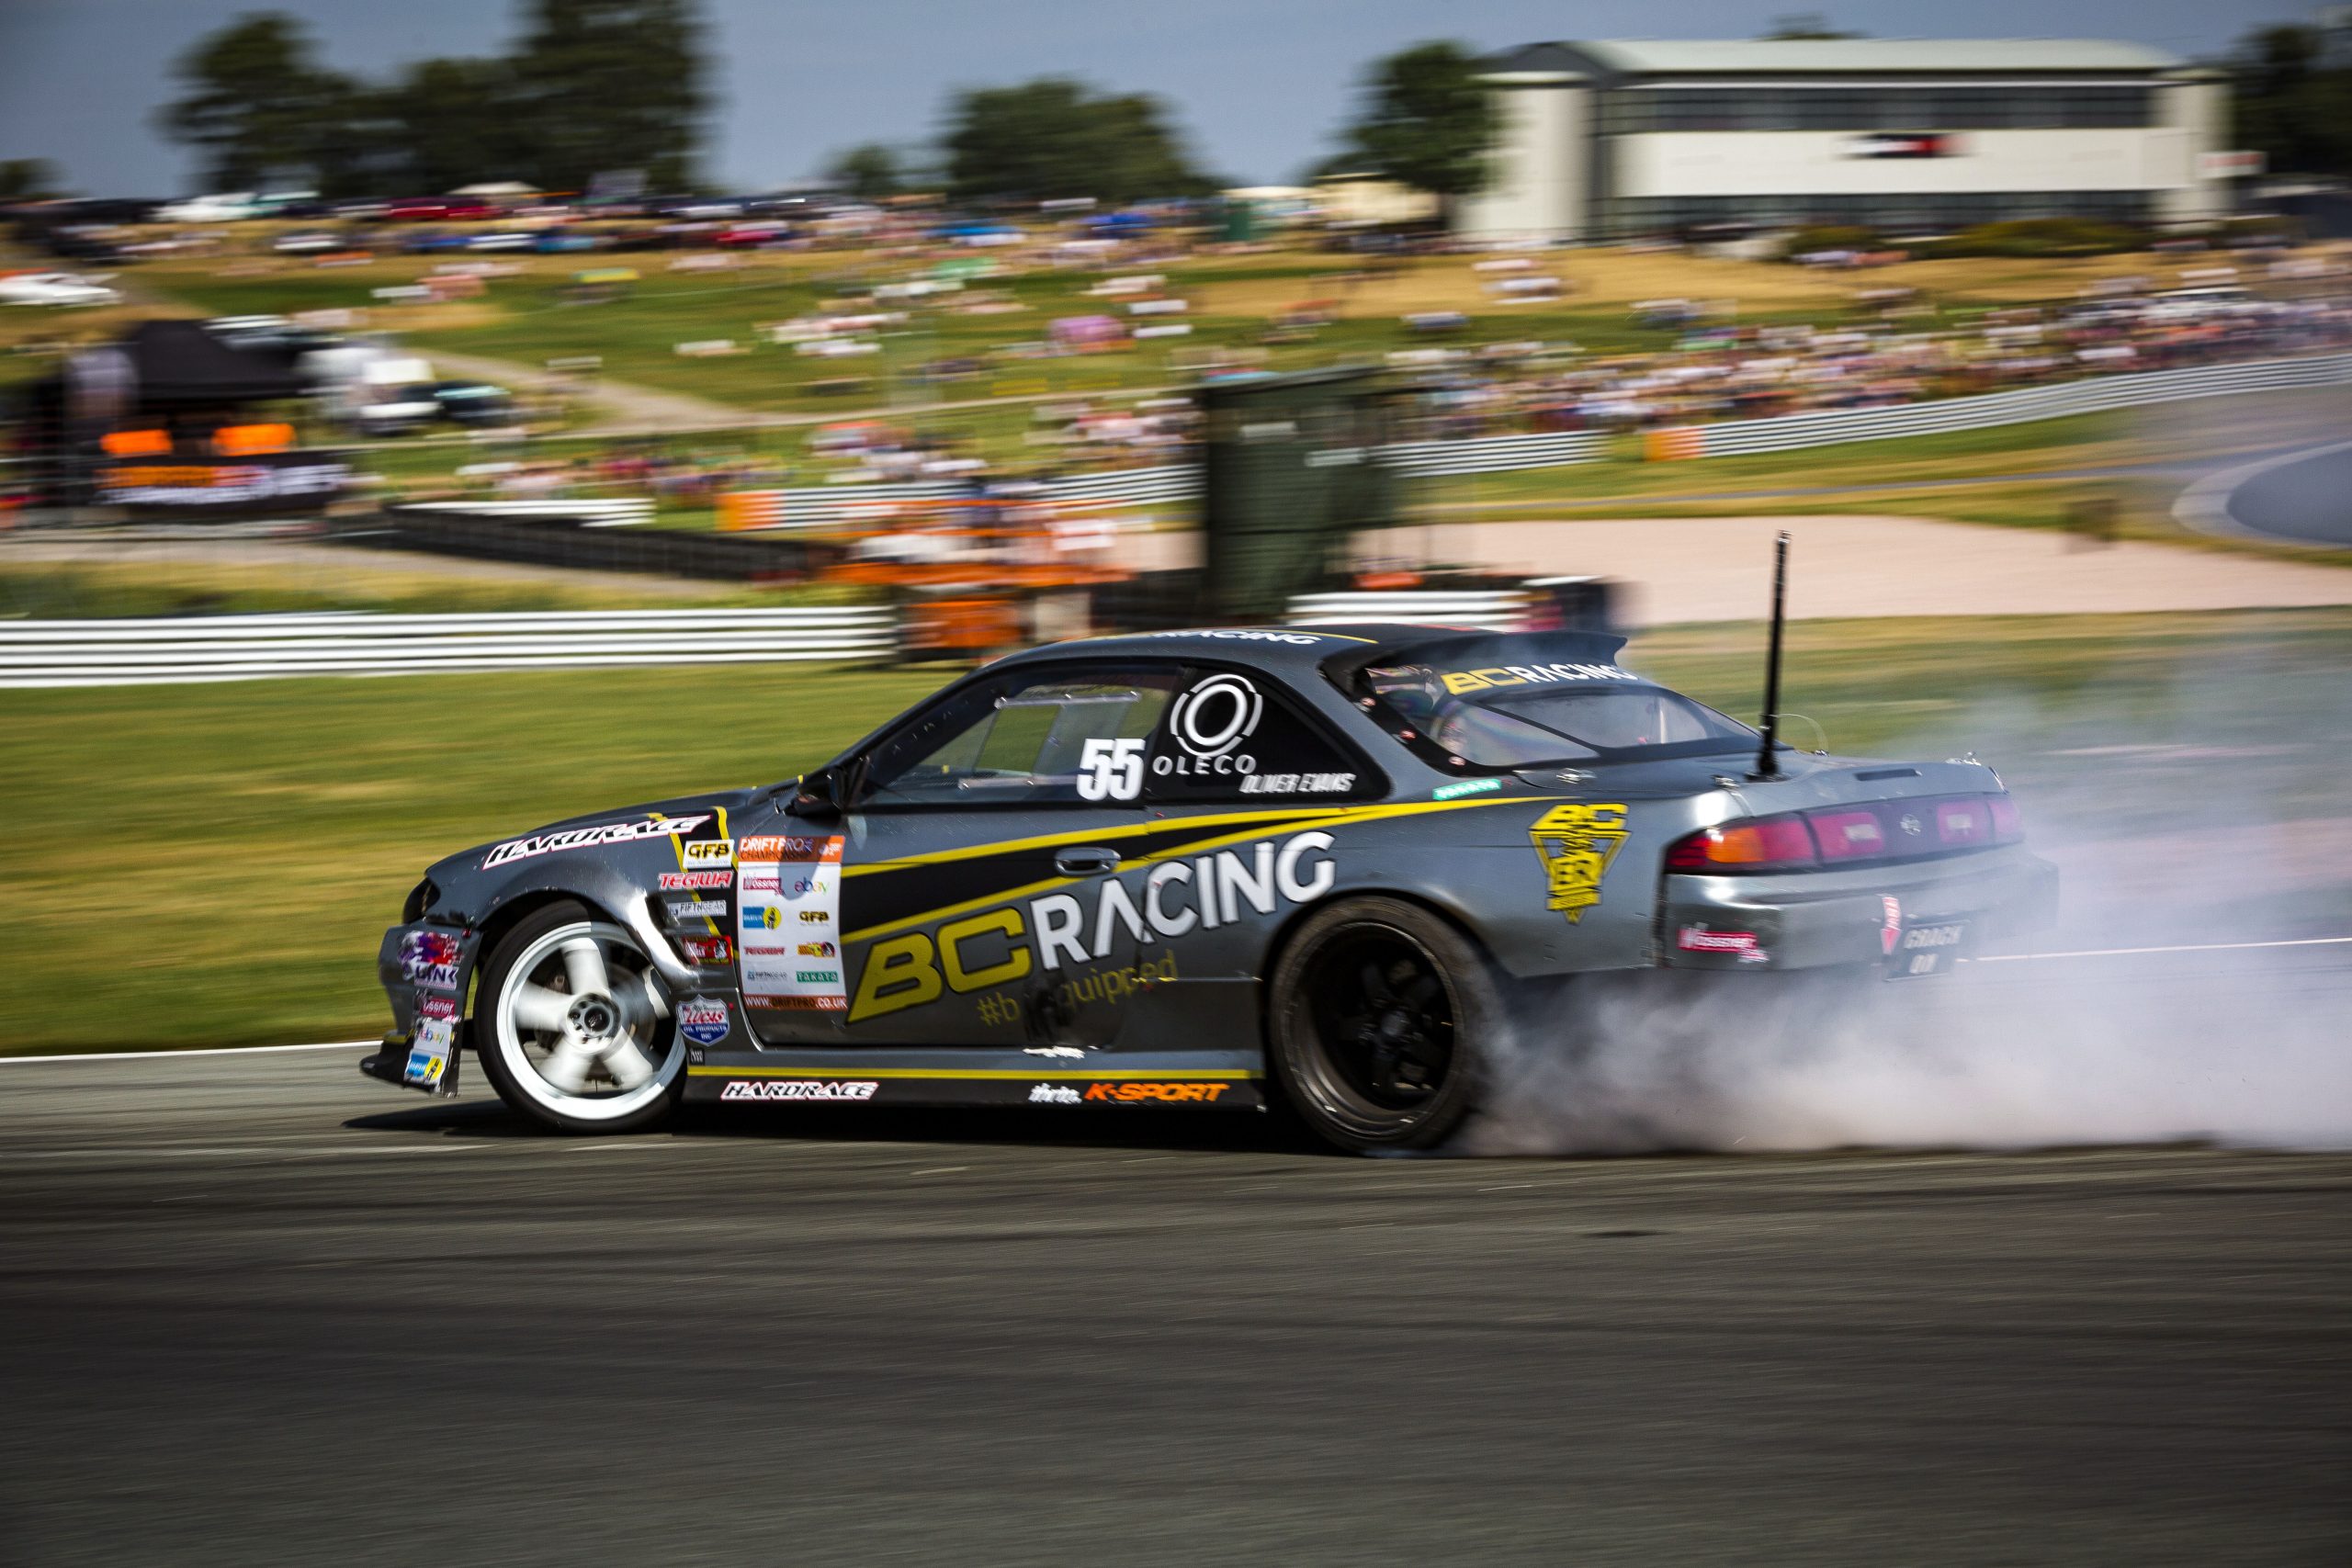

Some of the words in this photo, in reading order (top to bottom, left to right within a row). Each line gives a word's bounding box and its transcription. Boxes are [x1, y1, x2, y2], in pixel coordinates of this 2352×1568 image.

[1077, 738, 1146, 801] 55
[1152, 754, 1257, 776] OLECO
[483, 815, 713, 870] HARDRACE
[659, 871, 733, 890] TEGIWA
[794, 876, 830, 896] ebay
[721, 1081, 879, 1101] HARDRACE
